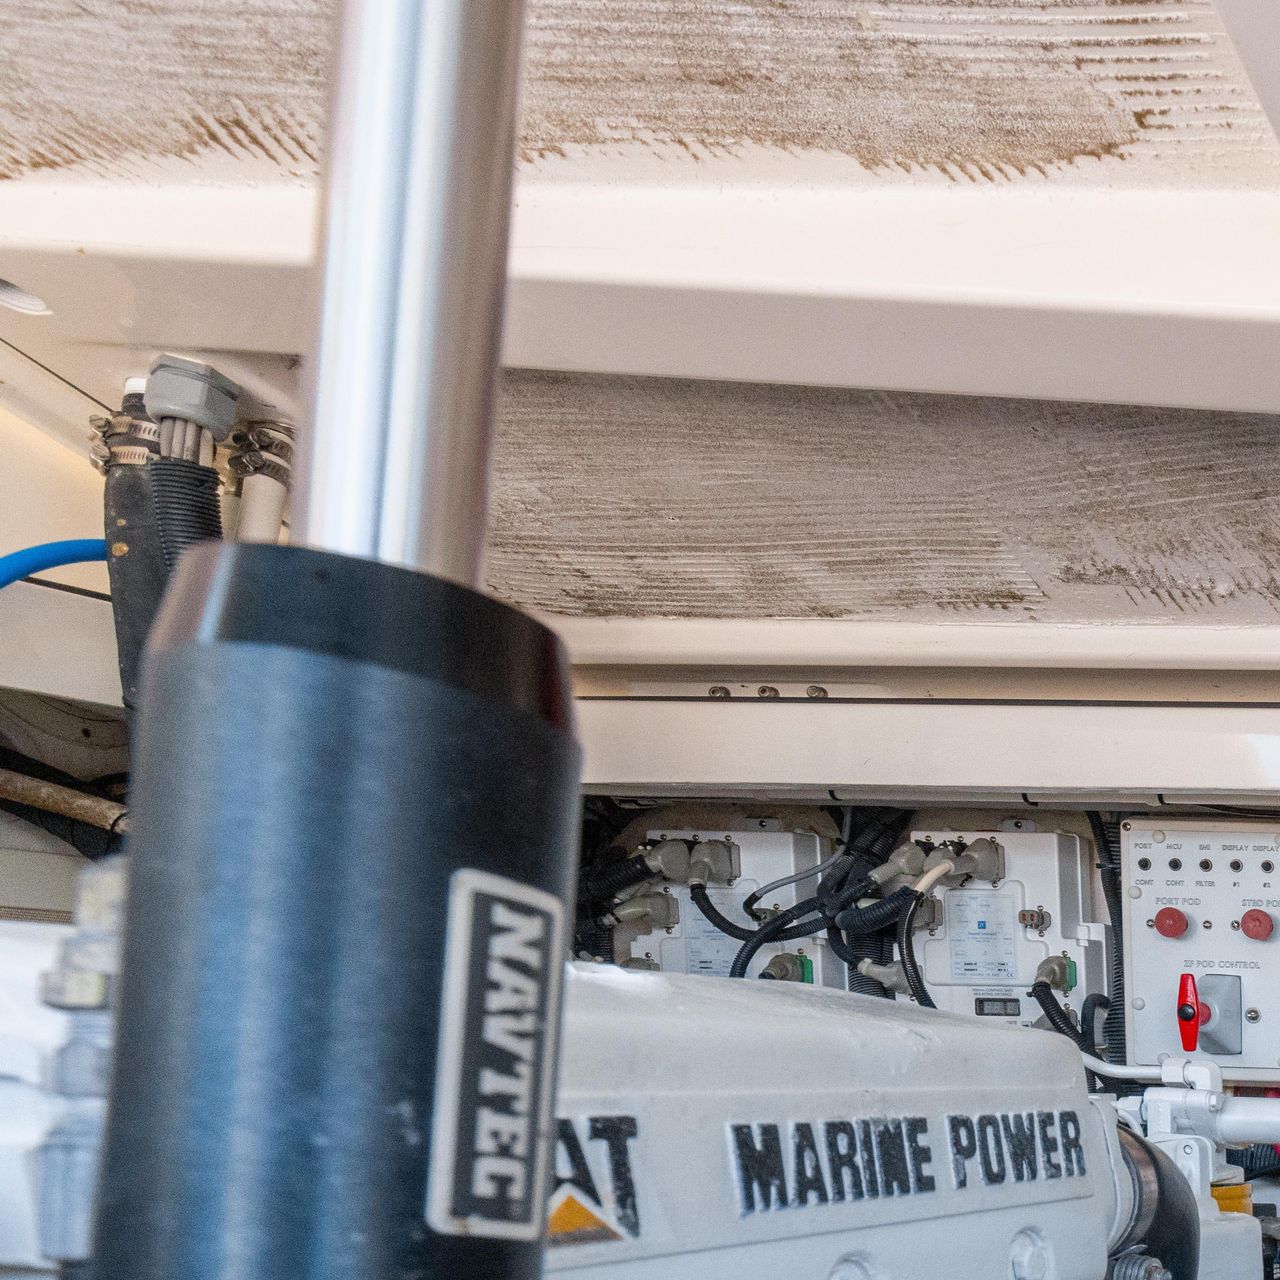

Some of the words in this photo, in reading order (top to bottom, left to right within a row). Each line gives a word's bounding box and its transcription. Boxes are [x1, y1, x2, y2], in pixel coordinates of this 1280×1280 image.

[471, 901, 545, 1201] NAVTEC
[551, 1114, 640, 1238] AT
[731, 1115, 936, 1214] MARINE
[945, 1110, 1087, 1189] POWER
